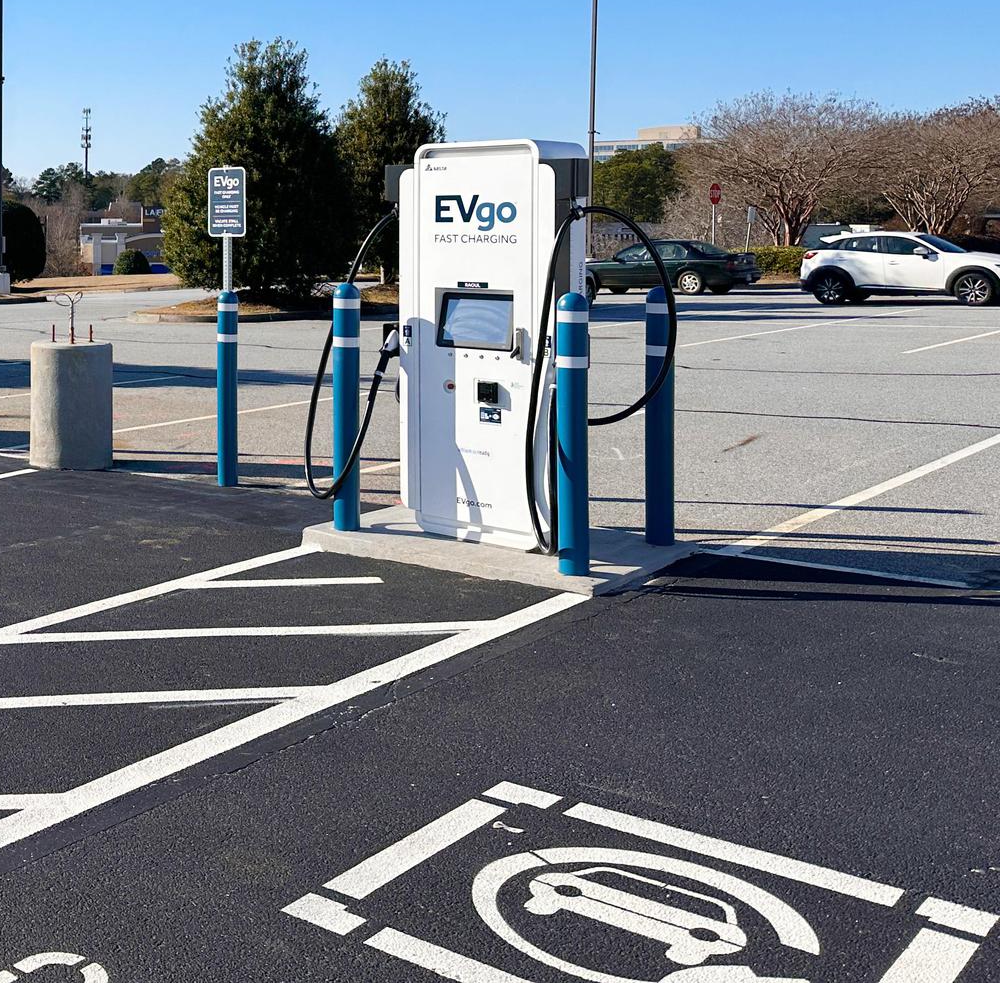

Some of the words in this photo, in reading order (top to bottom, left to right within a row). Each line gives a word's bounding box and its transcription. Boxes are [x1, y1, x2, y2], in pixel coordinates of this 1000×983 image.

[214, 176, 239, 189] EVgo
[435, 194, 517, 231] EVgo
[434, 234, 458, 243] FAST
[461, 234, 517, 244] CHARGING
[456, 497, 492, 509] EVgo.com
